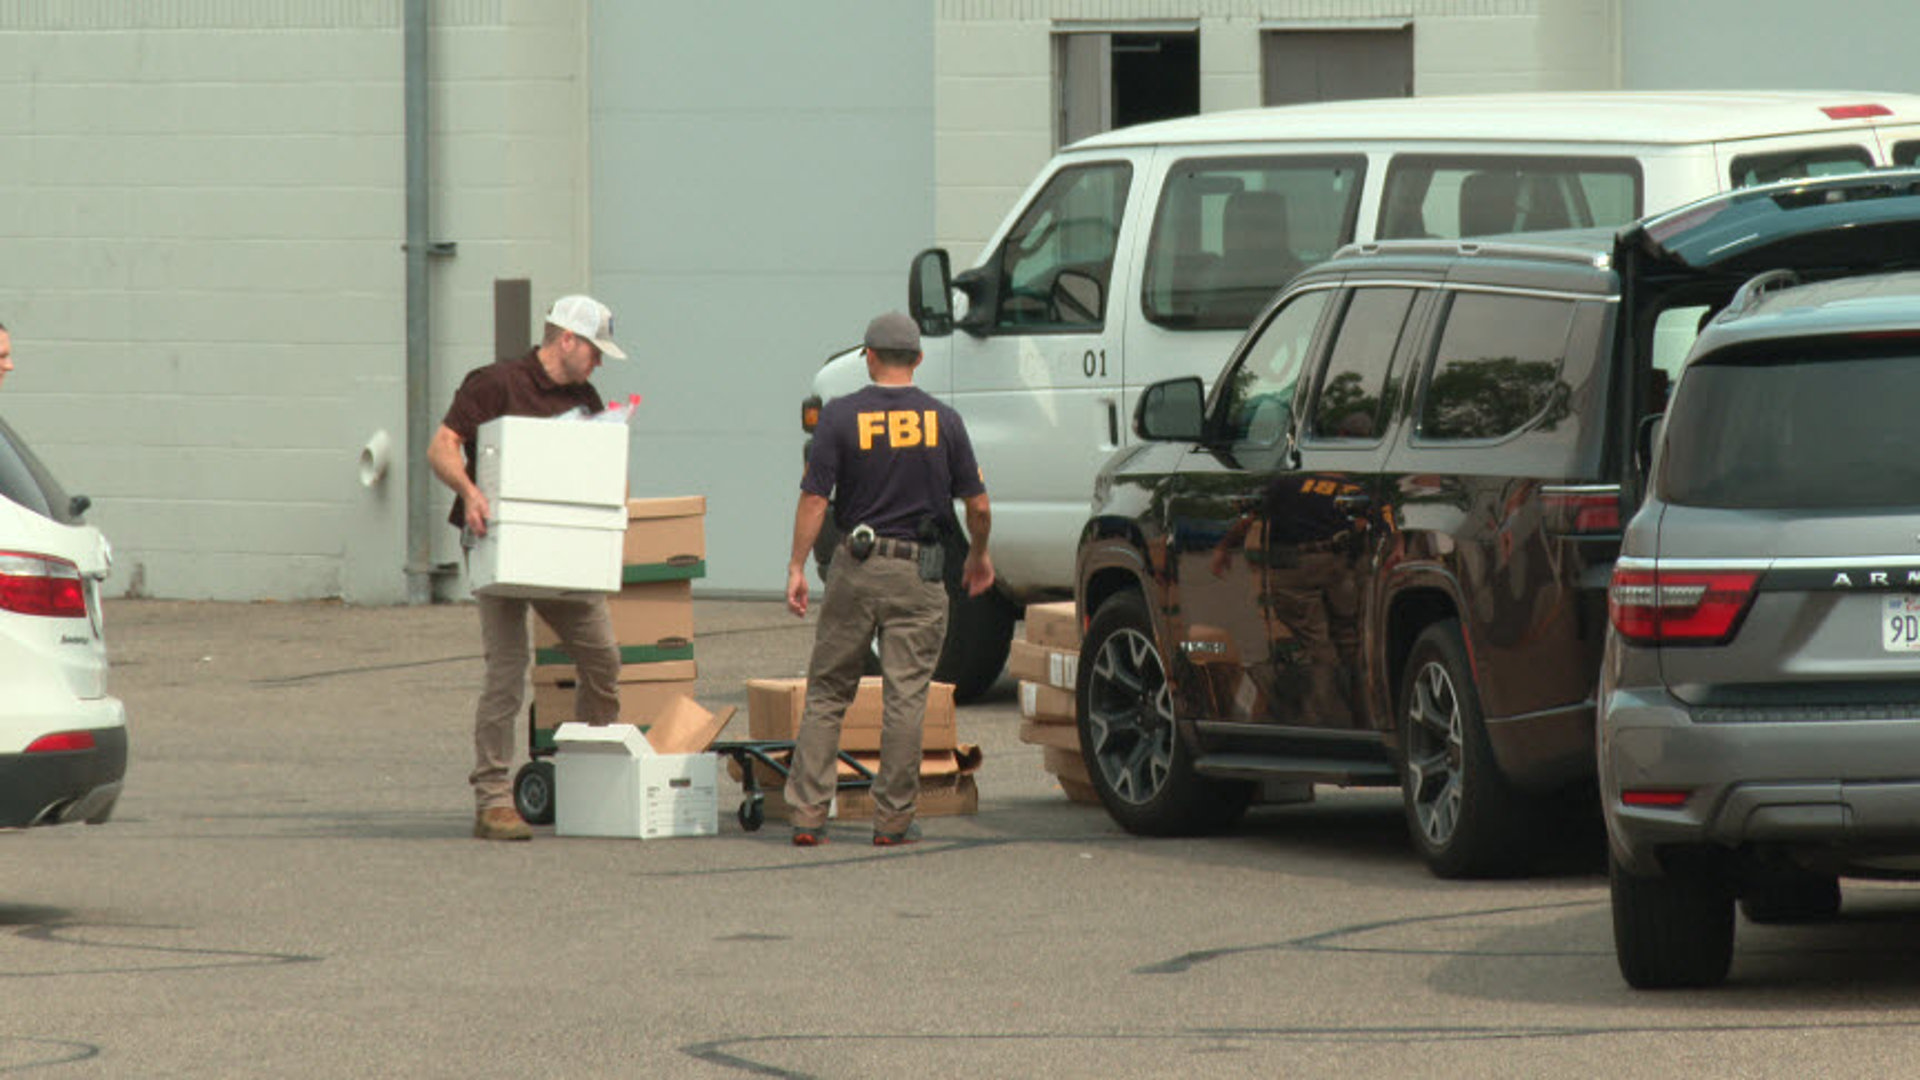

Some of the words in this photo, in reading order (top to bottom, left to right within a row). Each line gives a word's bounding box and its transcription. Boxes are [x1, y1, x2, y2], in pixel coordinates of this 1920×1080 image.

[1083, 349, 1107, 378] 01
[857, 410, 939, 450] FBI
[1891, 615, 1919, 643] 9D
